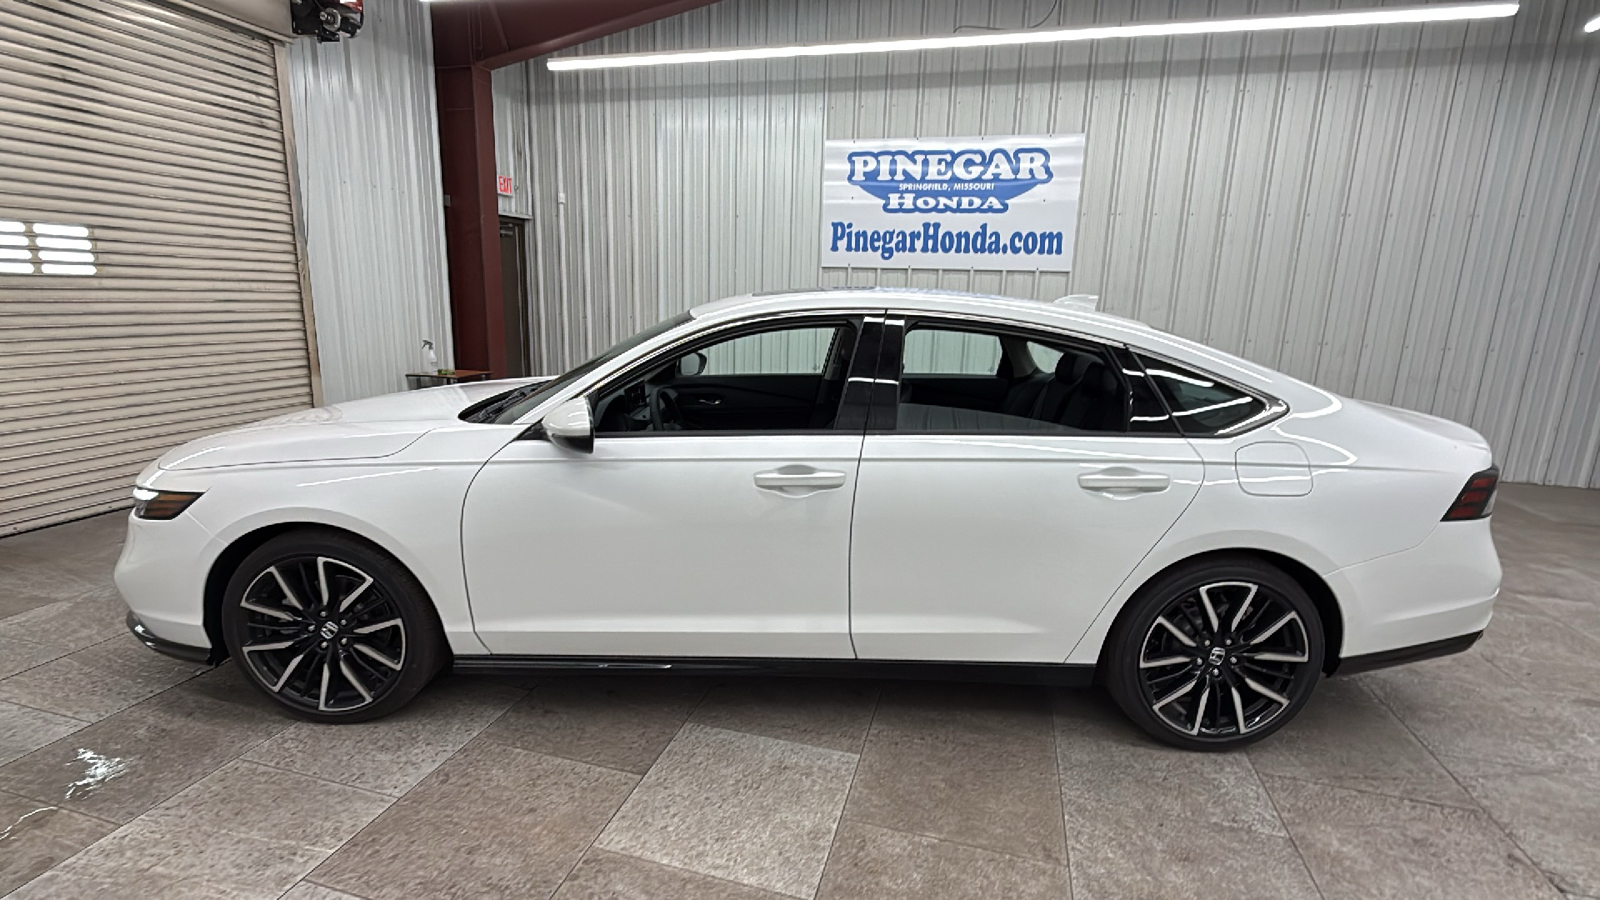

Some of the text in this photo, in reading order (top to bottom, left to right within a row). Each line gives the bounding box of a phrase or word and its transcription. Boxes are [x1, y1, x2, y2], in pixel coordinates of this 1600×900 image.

[851, 152, 1049, 181] PINEGAR
[499, 175, 512, 194] EXIT
[899, 182, 995, 191] SPRINGFIELD, MISSOURI
[887, 193, 1004, 210] HONDA
[830, 221, 1063, 260] PinegarHonda.com
